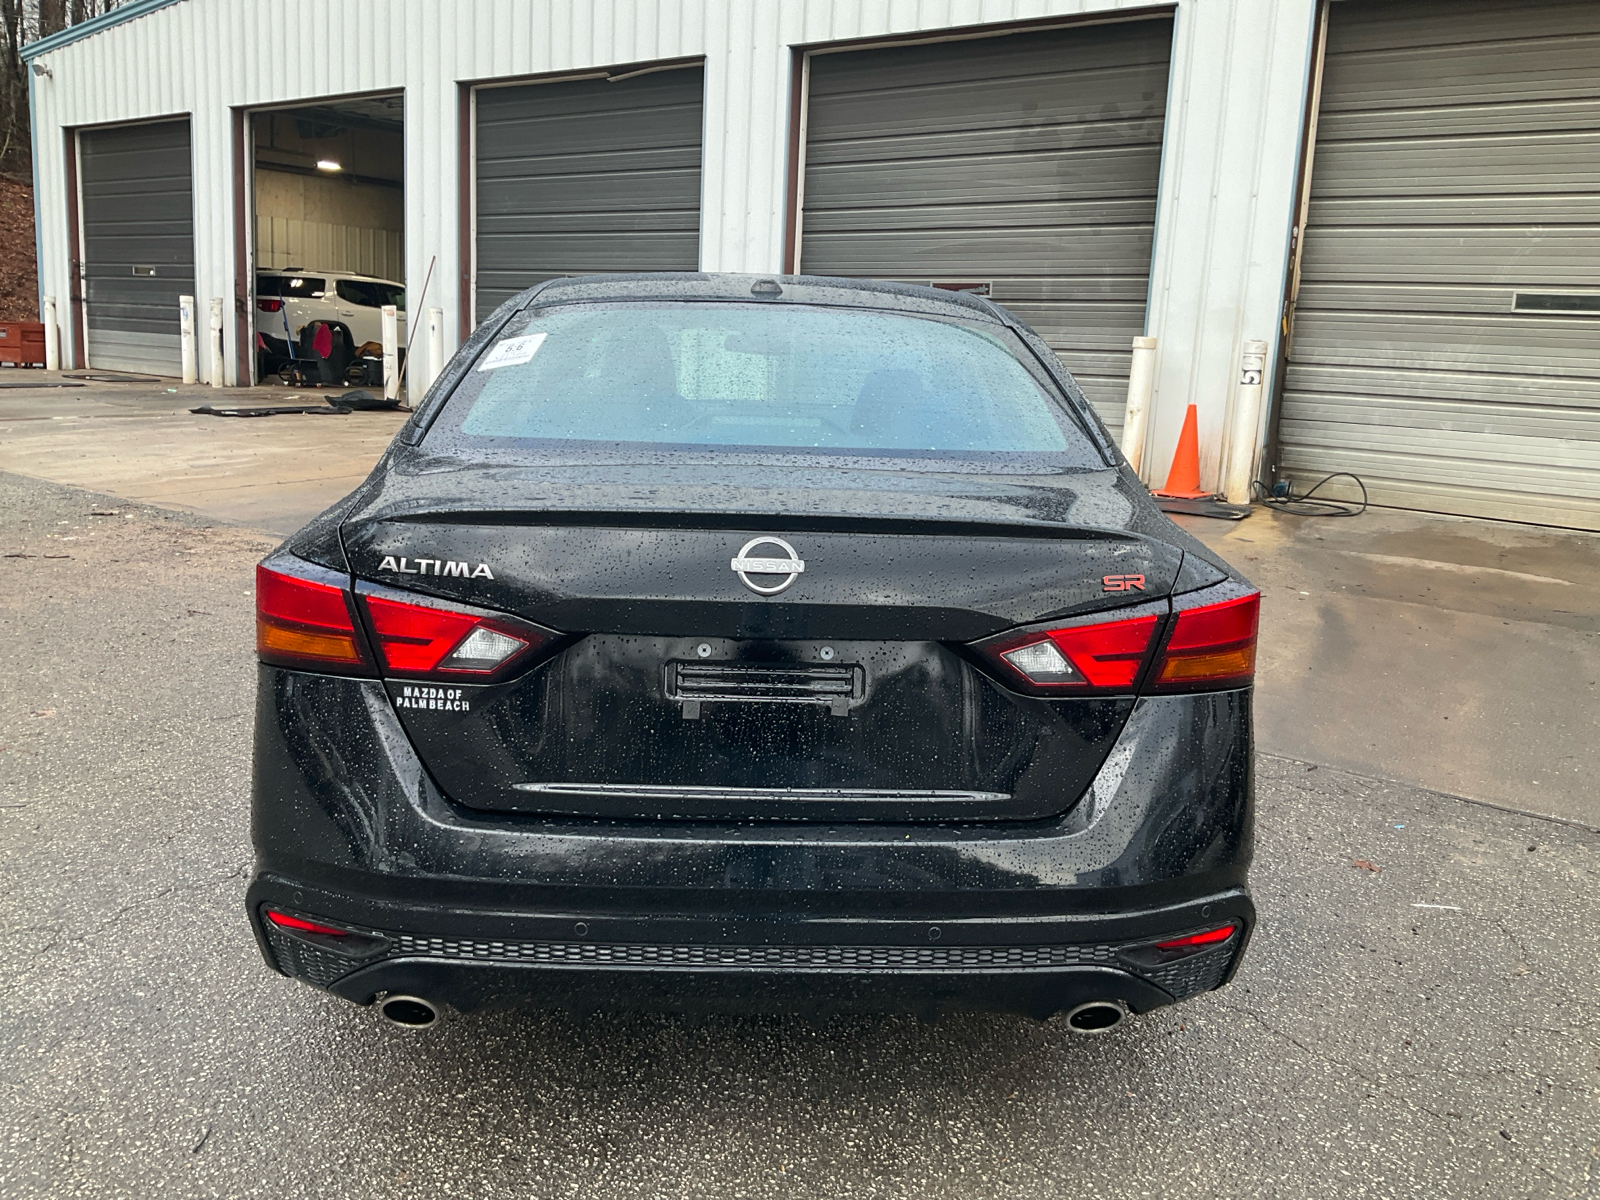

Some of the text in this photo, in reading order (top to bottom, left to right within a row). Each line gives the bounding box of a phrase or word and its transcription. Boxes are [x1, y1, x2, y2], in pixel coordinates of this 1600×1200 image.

[377, 555, 495, 580] ALTIMA
[733, 560, 803, 572] NISSAN
[1103, 574, 1145, 591] SR
